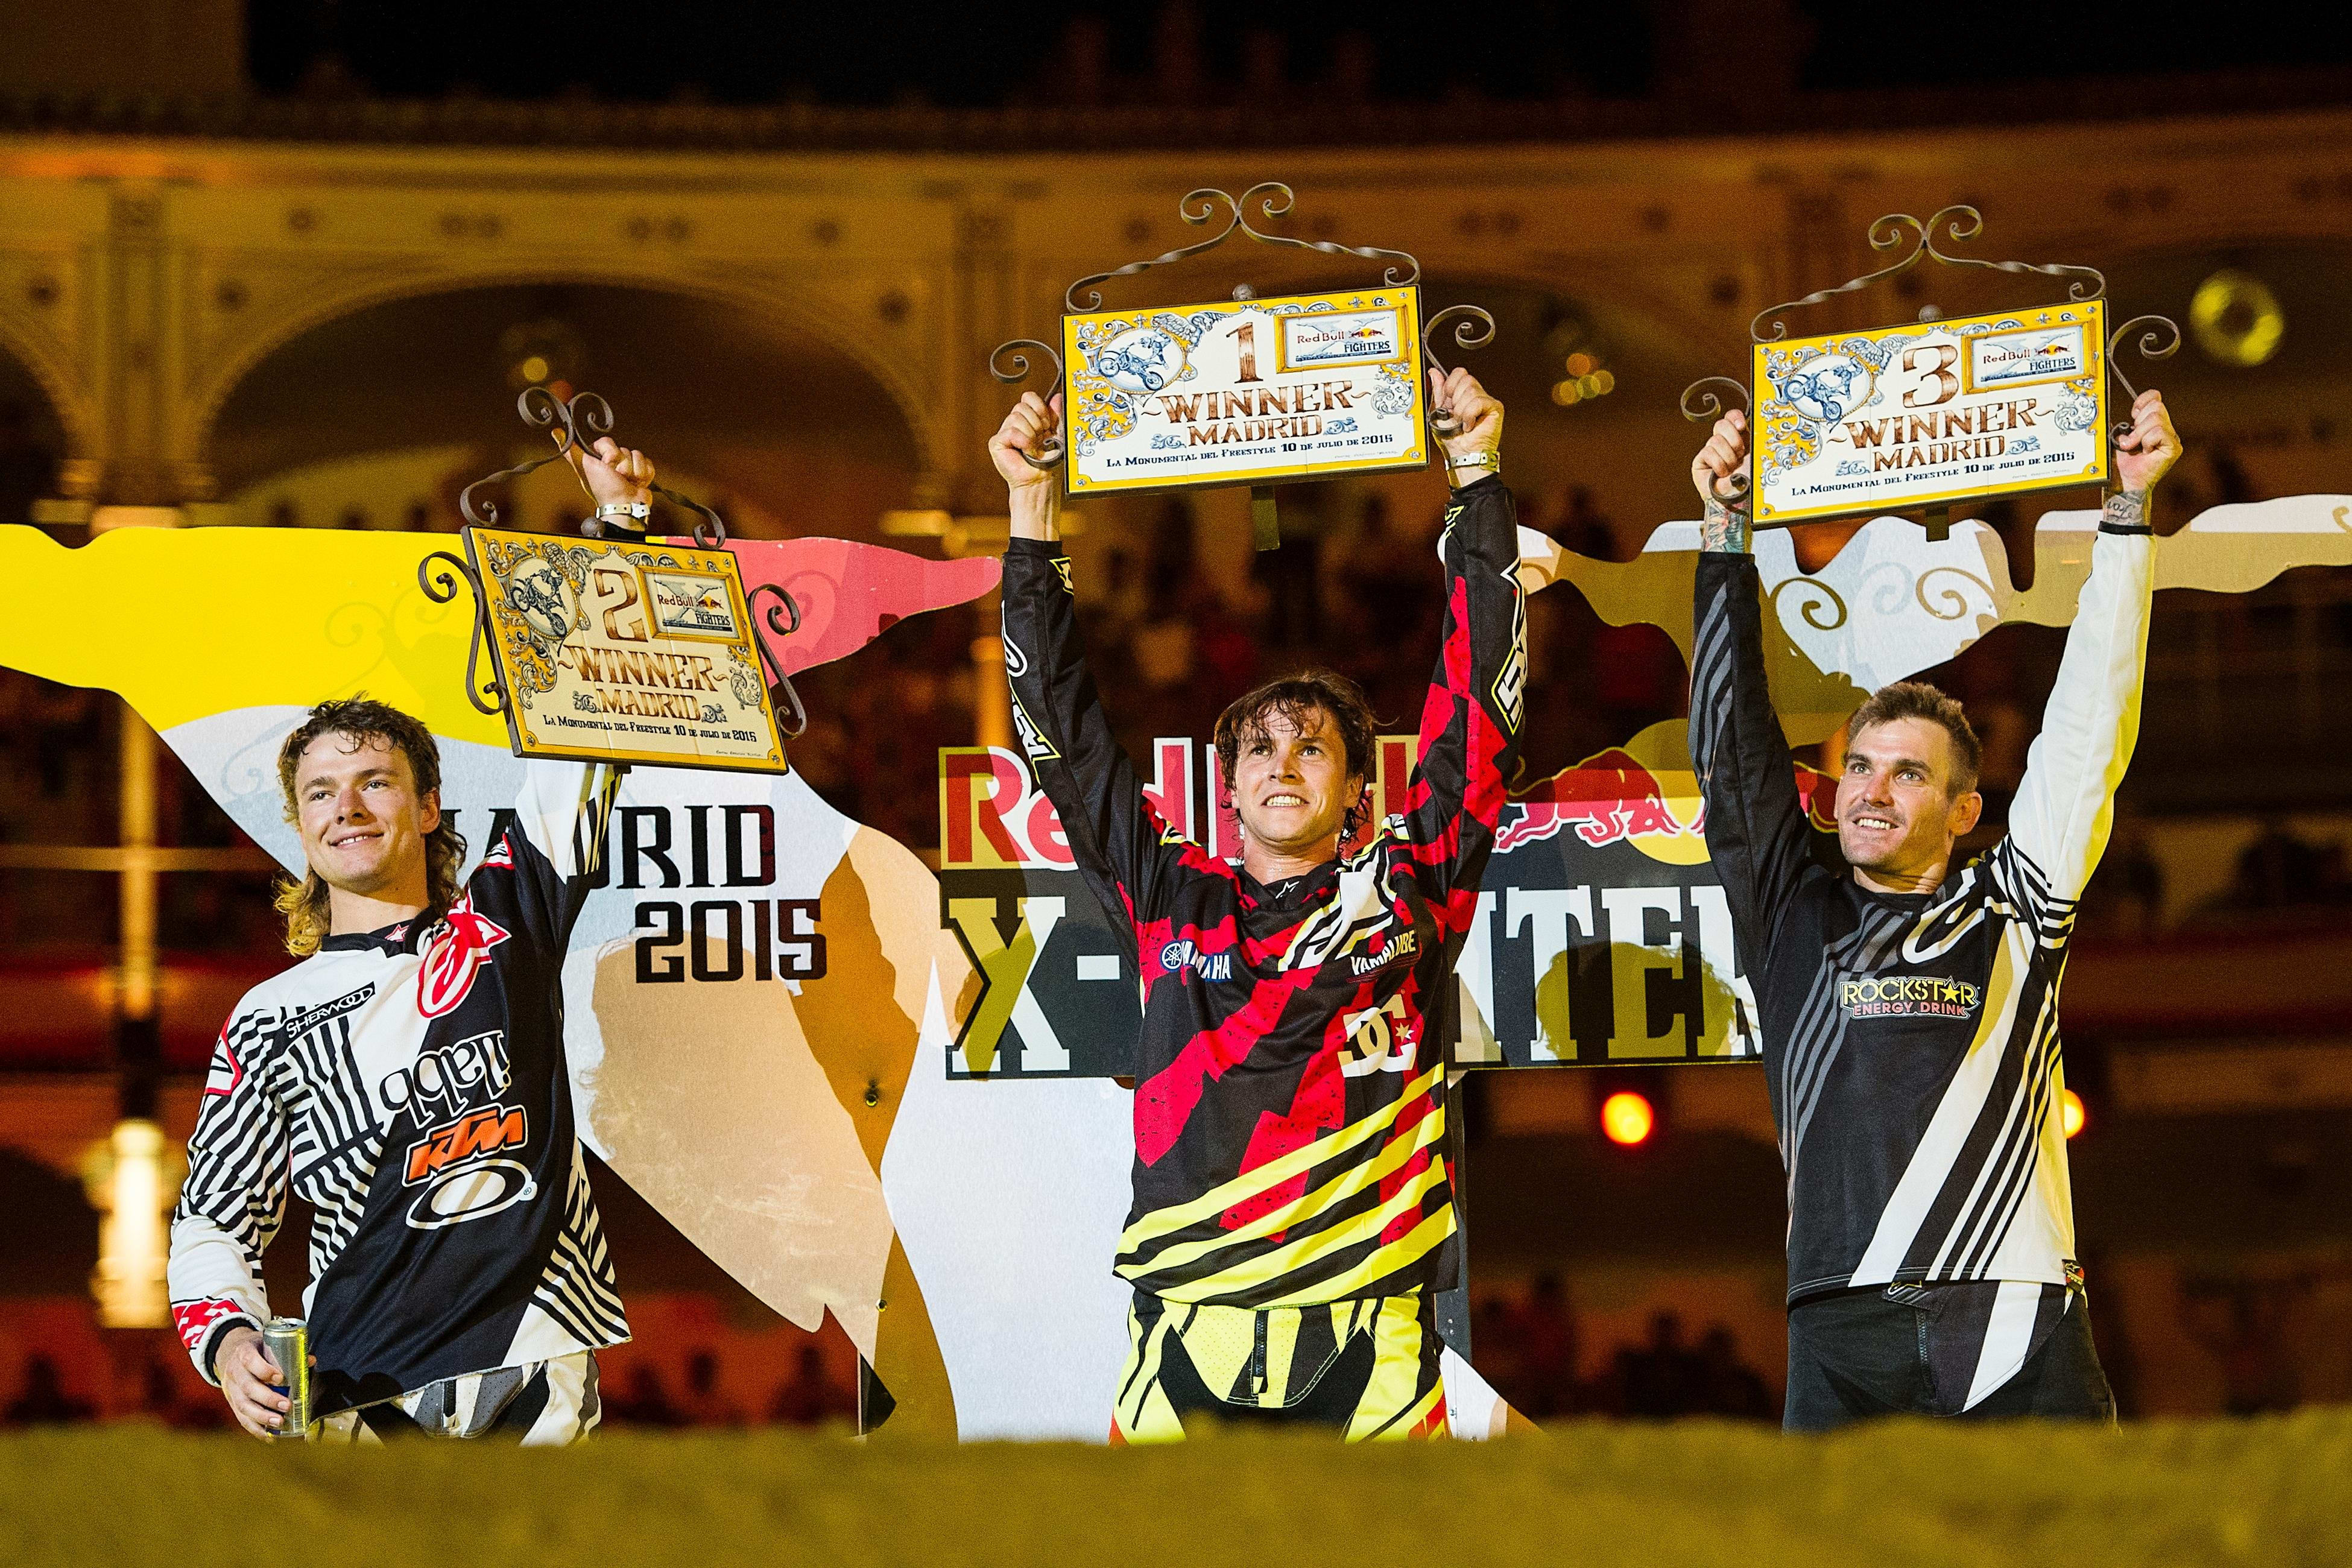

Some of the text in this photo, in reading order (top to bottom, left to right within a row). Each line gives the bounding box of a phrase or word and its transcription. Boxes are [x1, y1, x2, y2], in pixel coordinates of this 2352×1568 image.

[1226, 321, 1264, 384] 1
[1297, 331, 1344, 344] Red Bull
[1344, 341, 1389, 352] FIGHTERS
[1984, 349, 2030, 364] Red Bull
[2029, 358, 2075, 371] FIGHTERS
[1903, 344, 1959, 408] 3
[1155, 380, 1354, 423] WINNER
[1187, 414, 1323, 447] MADRID
[1842, 398, 2038, 450] WINNER
[1281, 443, 1297, 452] 10
[1362, 434, 1393, 444] 2015
[1873, 435, 2005, 472] MADRID
[1964, 464, 1979, 474] 10
[2043, 452, 2075, 463] 2015
[593, 569, 648, 642] 2
[657, 595, 694, 607] Red Bull
[695, 613, 730, 626] FIGHTERS
[563, 645, 718, 692] WINNER
[596, 689, 701, 721] MADRID
[674, 724, 686, 736] 10
[732, 730, 757, 742] 2015
[635, 899, 827, 983] 2015
[1351, 930, 1416, 976] YAMALUBE
[286, 984, 374, 1038] SHERWOOD
[1853, 1002, 1966, 1016] ENERGY DRINK
[404, 1105, 526, 1185] KTM
